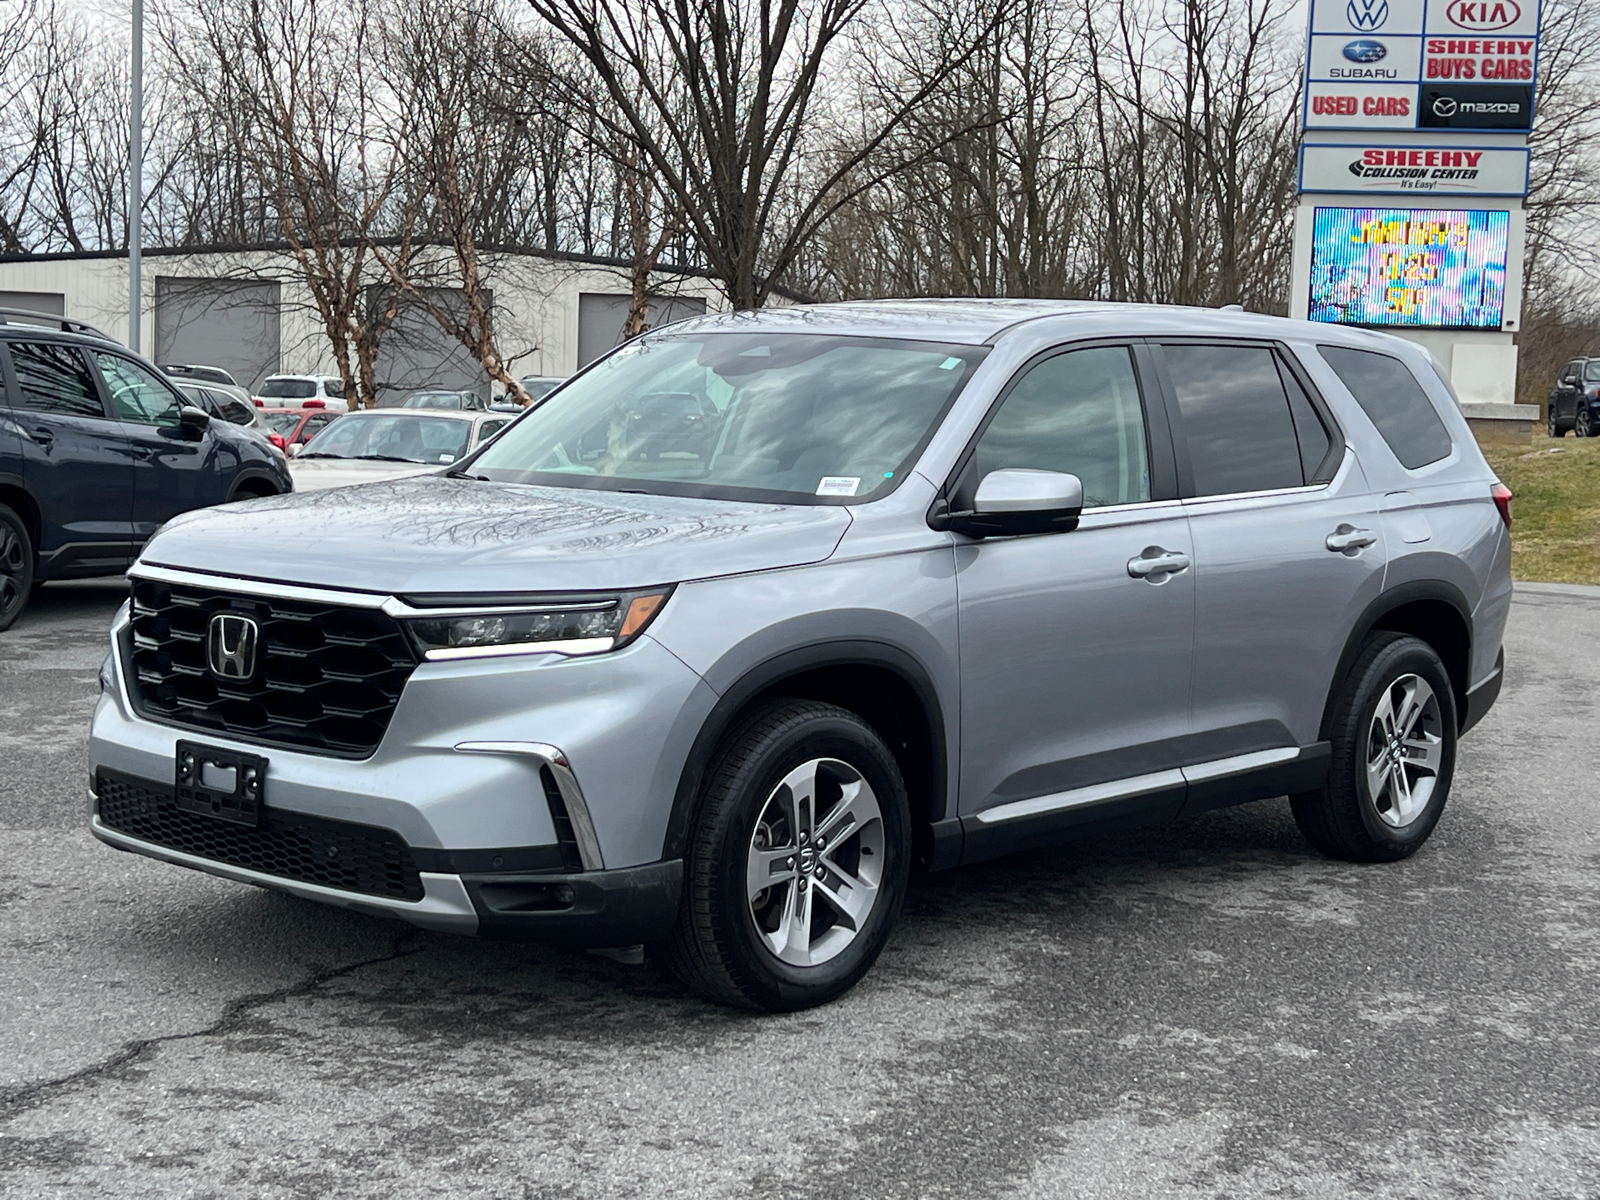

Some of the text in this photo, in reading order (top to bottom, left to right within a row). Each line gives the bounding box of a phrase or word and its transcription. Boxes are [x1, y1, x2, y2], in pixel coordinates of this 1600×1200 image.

[1459, 3, 1508, 22] KIA
[1427, 40, 1534, 55] SHEEHY
[1329, 68, 1397, 79] SUBARU
[1426, 58, 1533, 79] BUYS CARS
[1312, 96, 1411, 116] USED CARS
[1460, 103, 1520, 113] mazda
[1363, 150, 1483, 167] SHEEHY
[1362, 167, 1479, 179] COLLISION CENTER
[1401, 180, 1438, 190] It's Easy!
